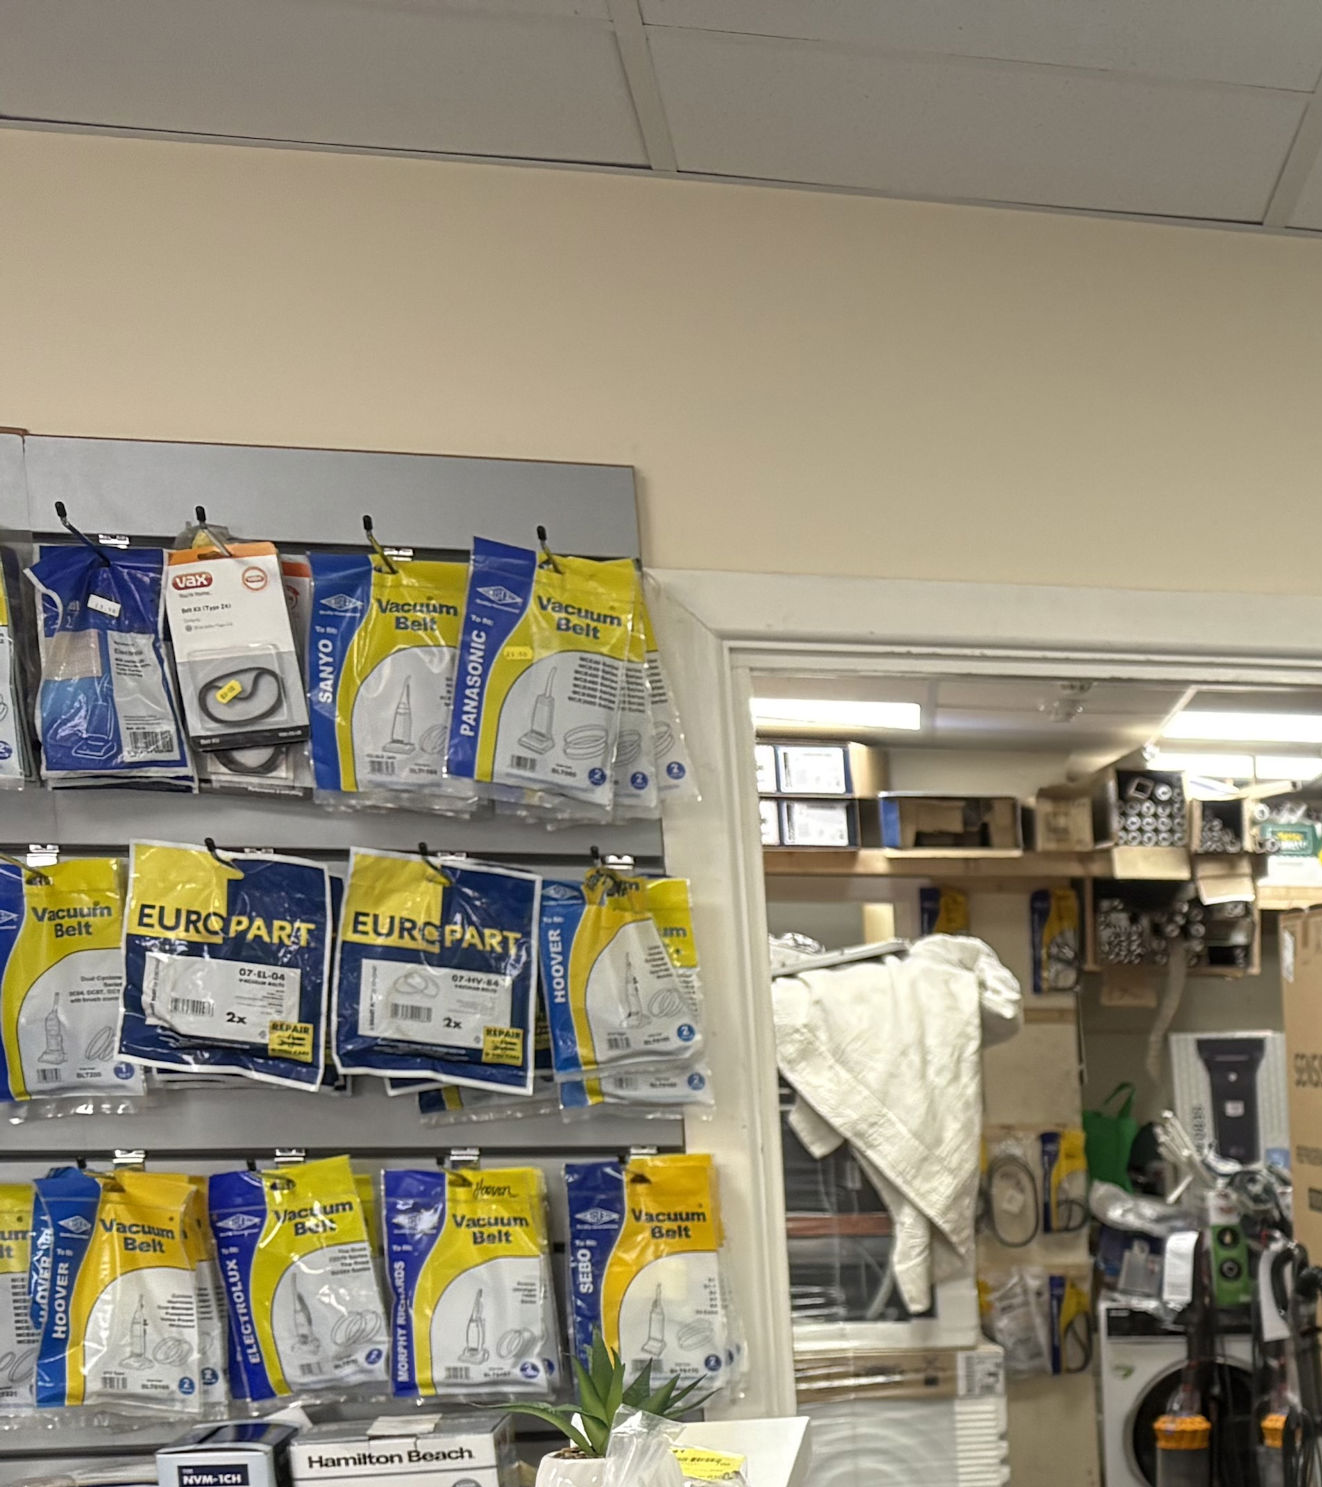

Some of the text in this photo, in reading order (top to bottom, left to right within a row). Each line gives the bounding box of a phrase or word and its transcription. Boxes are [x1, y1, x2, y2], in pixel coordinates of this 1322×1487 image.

[174, 574, 209, 588] vax
[377, 598, 458, 617] Vacuum
[537, 594, 622, 628] Vacuum
[395, 615, 438, 632] Belt
[556, 616, 601, 640] Belt
[318, 639, 333, 704] SANYO
[459, 630, 487, 737] PANASONIC
[31, 902, 112, 923] Vacuum
[54, 921, 93, 938] Belt
[137, 903, 316, 947] EUROPART
[351, 910, 522, 957] EUROPART
[239, 967, 286, 981] 07-EL-04
[548, 928, 566, 1004] HOOVER
[226, 1011, 247, 1025] 2x
[443, 1017, 463, 1030] 2x
[271, 1022, 310, 1035] REPAIR
[485, 1027, 522, 1039] REPAIR
[273, 1199, 354, 1224] Vacuum
[631, 1208, 707, 1223] Vacuum
[100, 1218, 176, 1240] Vacuum
[294, 1220, 337, 1237] Belt
[452, 1213, 529, 1229] Vacuum
[472, 1230, 513, 1246] Belt
[651, 1225, 691, 1240] Belt
[123, 1237, 166, 1254] Belt
[577, 1249, 594, 1294] SEBO
[51, 1262, 70, 1340] HOOVER
[226, 1258, 261, 1364] ELECTROLUX
[307, 1447, 473, 1471] Hamilton Beach
[182, 1473, 242, 1487] NVM-1CH
